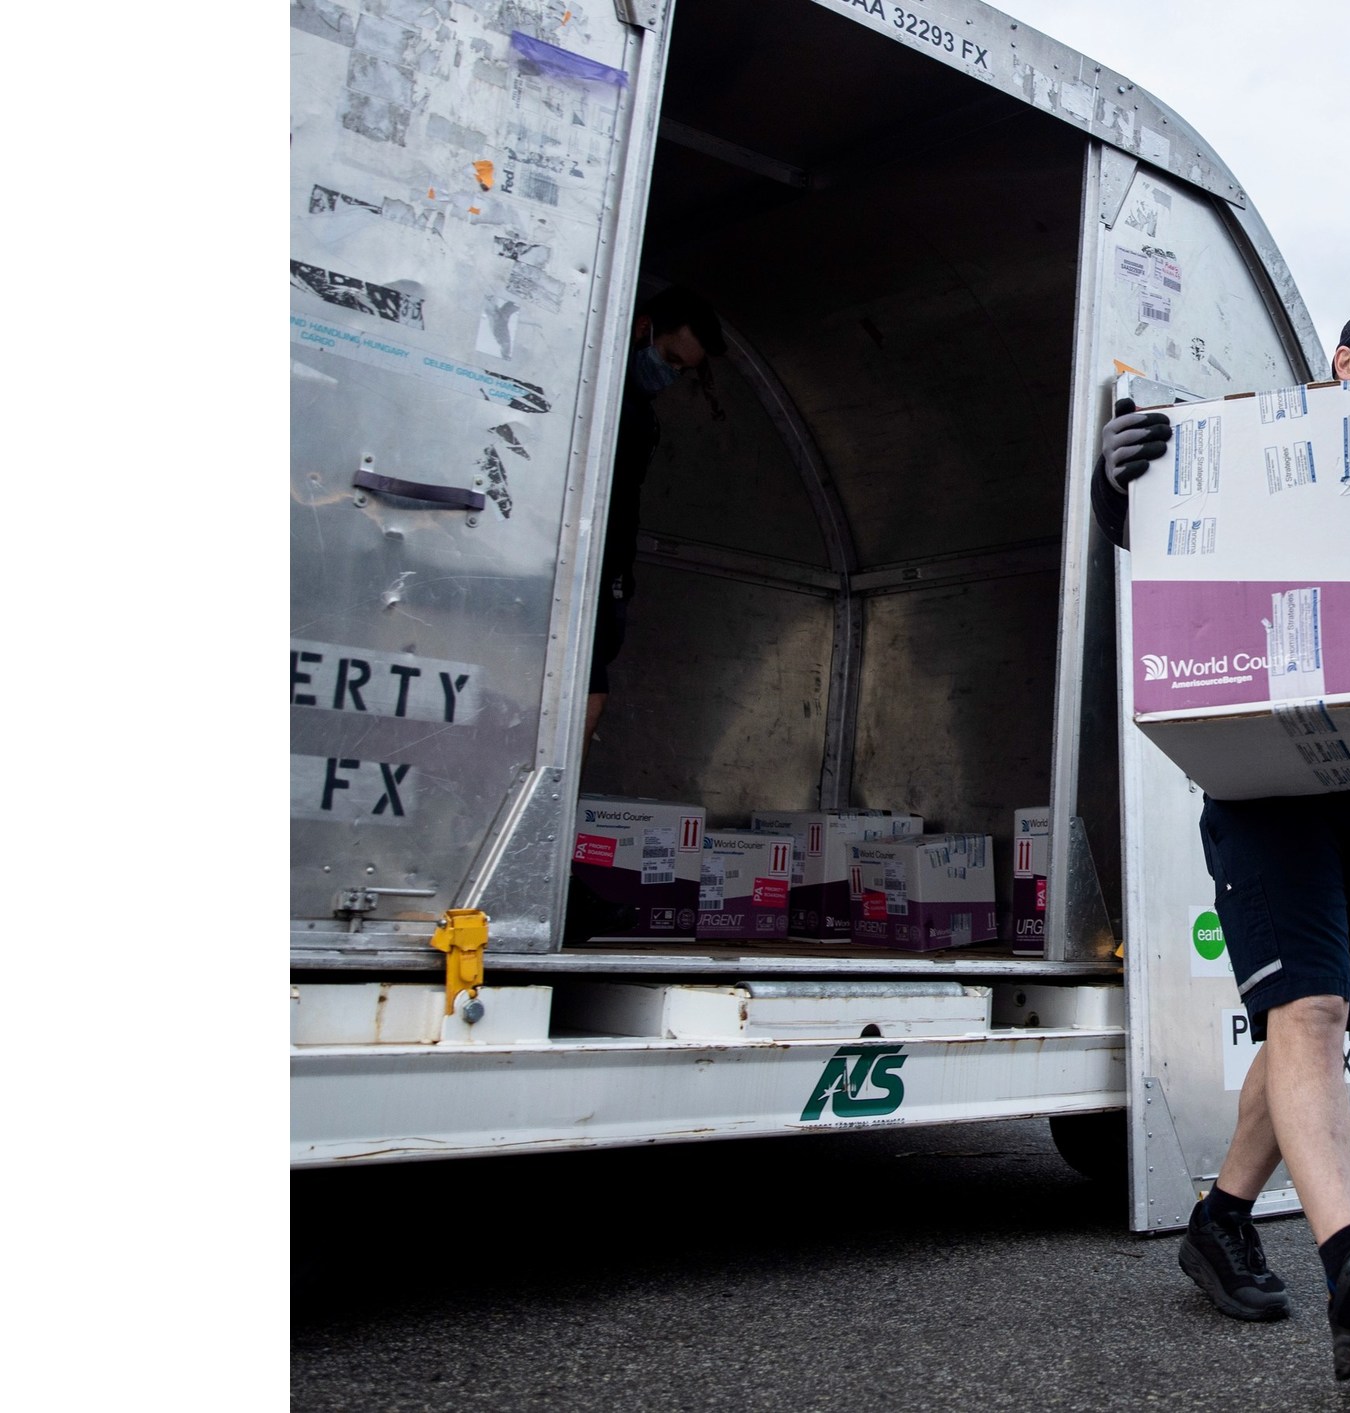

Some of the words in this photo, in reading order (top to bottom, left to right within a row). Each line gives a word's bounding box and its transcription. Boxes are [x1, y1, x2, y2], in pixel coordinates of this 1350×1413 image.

[842, 0, 885, 20] AA
[893, 7, 955, 52] 32293
[962, 39, 988, 69] FX
[301, 331, 335, 347] CARGO
[456, 367, 494, 384] GROUND
[1170, 655, 1228, 678] World
[1171, 675, 1253, 689] AmerisourceBergen
[320, 757, 411, 817] FX
[596, 810, 621, 821] World
[623, 812, 652, 822] Courier
[575, 843, 588, 859] PA
[714, 839, 736, 849] World
[737, 840, 764, 850] Courier
[859, 850, 874, 859] World
[1016, 919, 1044, 935] URG
[800, 1045, 909, 1121] ATS
